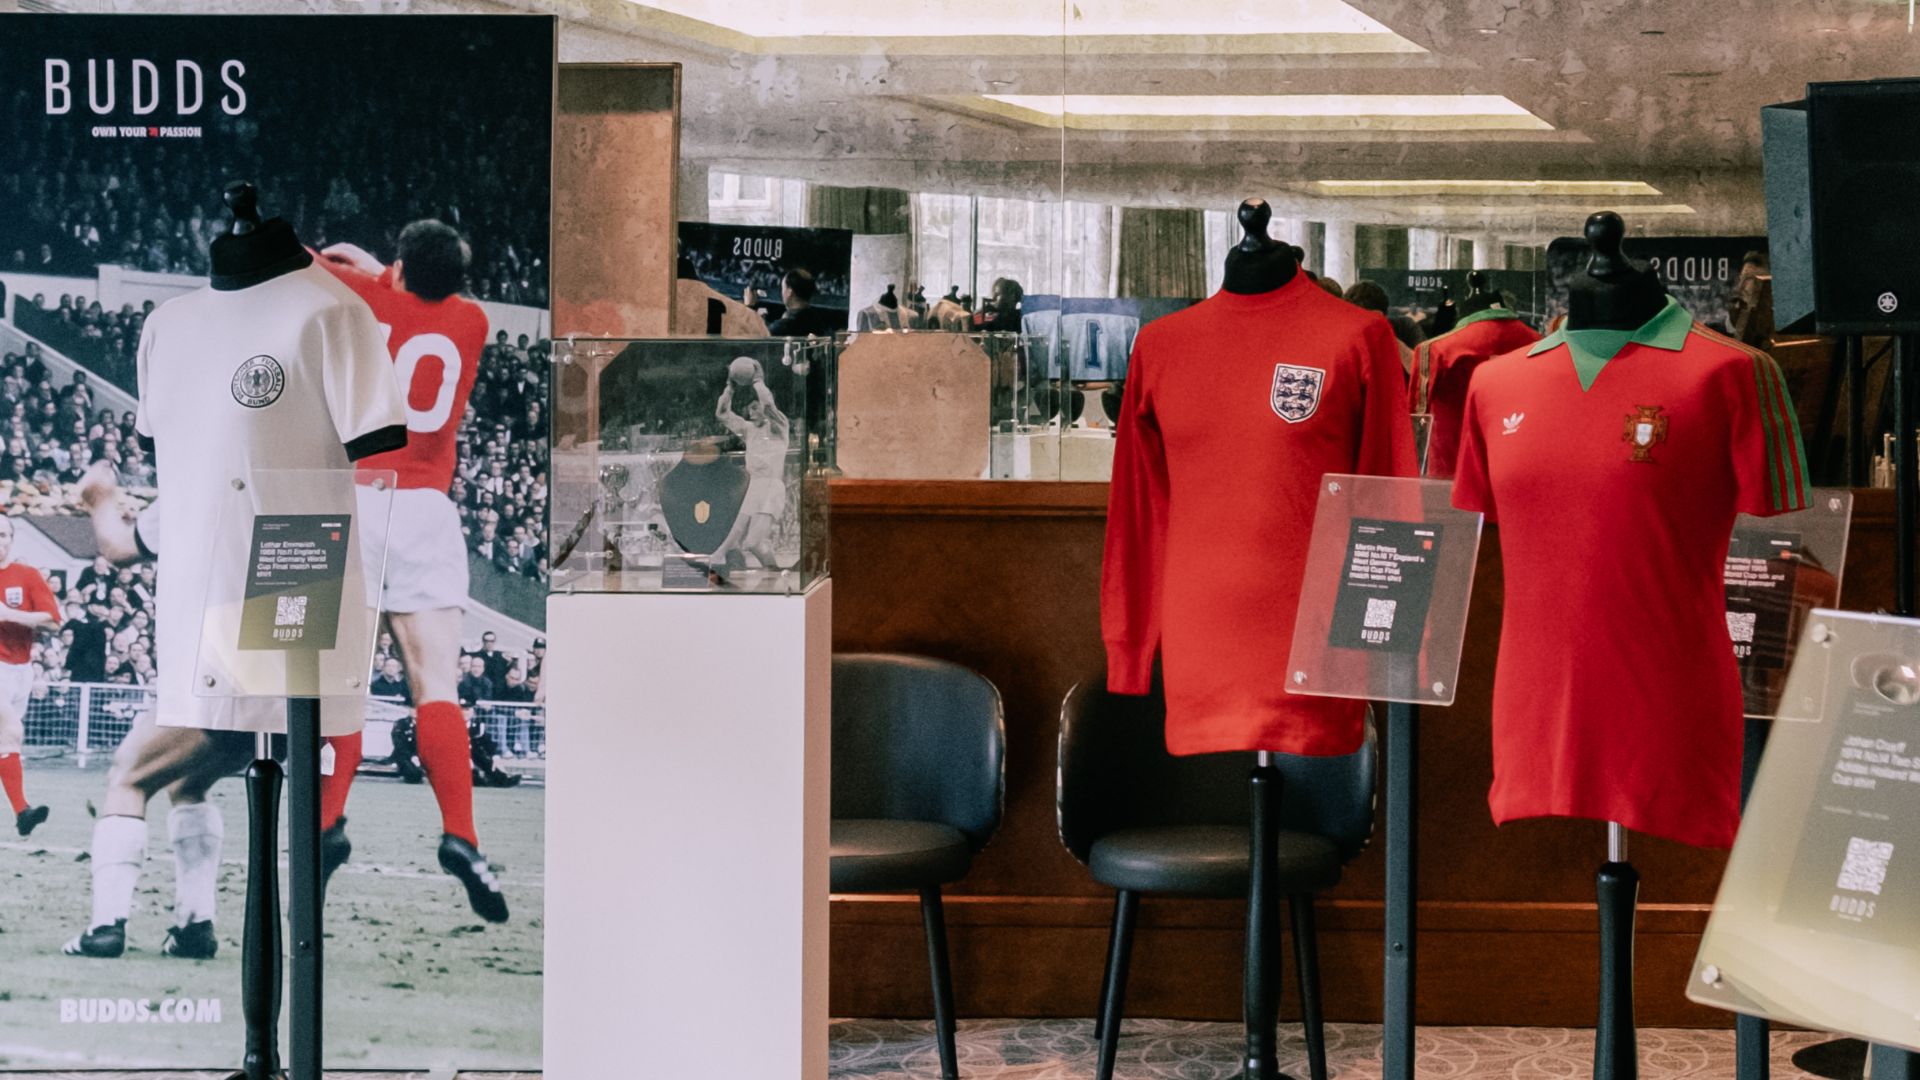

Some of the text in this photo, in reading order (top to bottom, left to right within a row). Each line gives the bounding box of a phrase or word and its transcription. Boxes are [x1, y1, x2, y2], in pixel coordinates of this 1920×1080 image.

[45, 58, 247, 116] BUDDS
[91, 126, 202, 138] OWN YOUR PASSION
[247, 396, 271, 405] BUND
[293, 548, 321, 556] England
[1355, 543, 1397, 553] Martin Peters
[276, 555, 306, 563] Germany
[1352, 557, 1398, 568] West Germany
[1350, 564, 1370, 573] World
[1370, 566, 1384, 574] Cup
[272, 628, 304, 638] BUDDS
[1361, 629, 1391, 642] BUDDS
[1733, 644, 1752, 656] DDS
[1829, 894, 1877, 918] BUDDS
[60, 998, 222, 1023] BUDDS.COM
